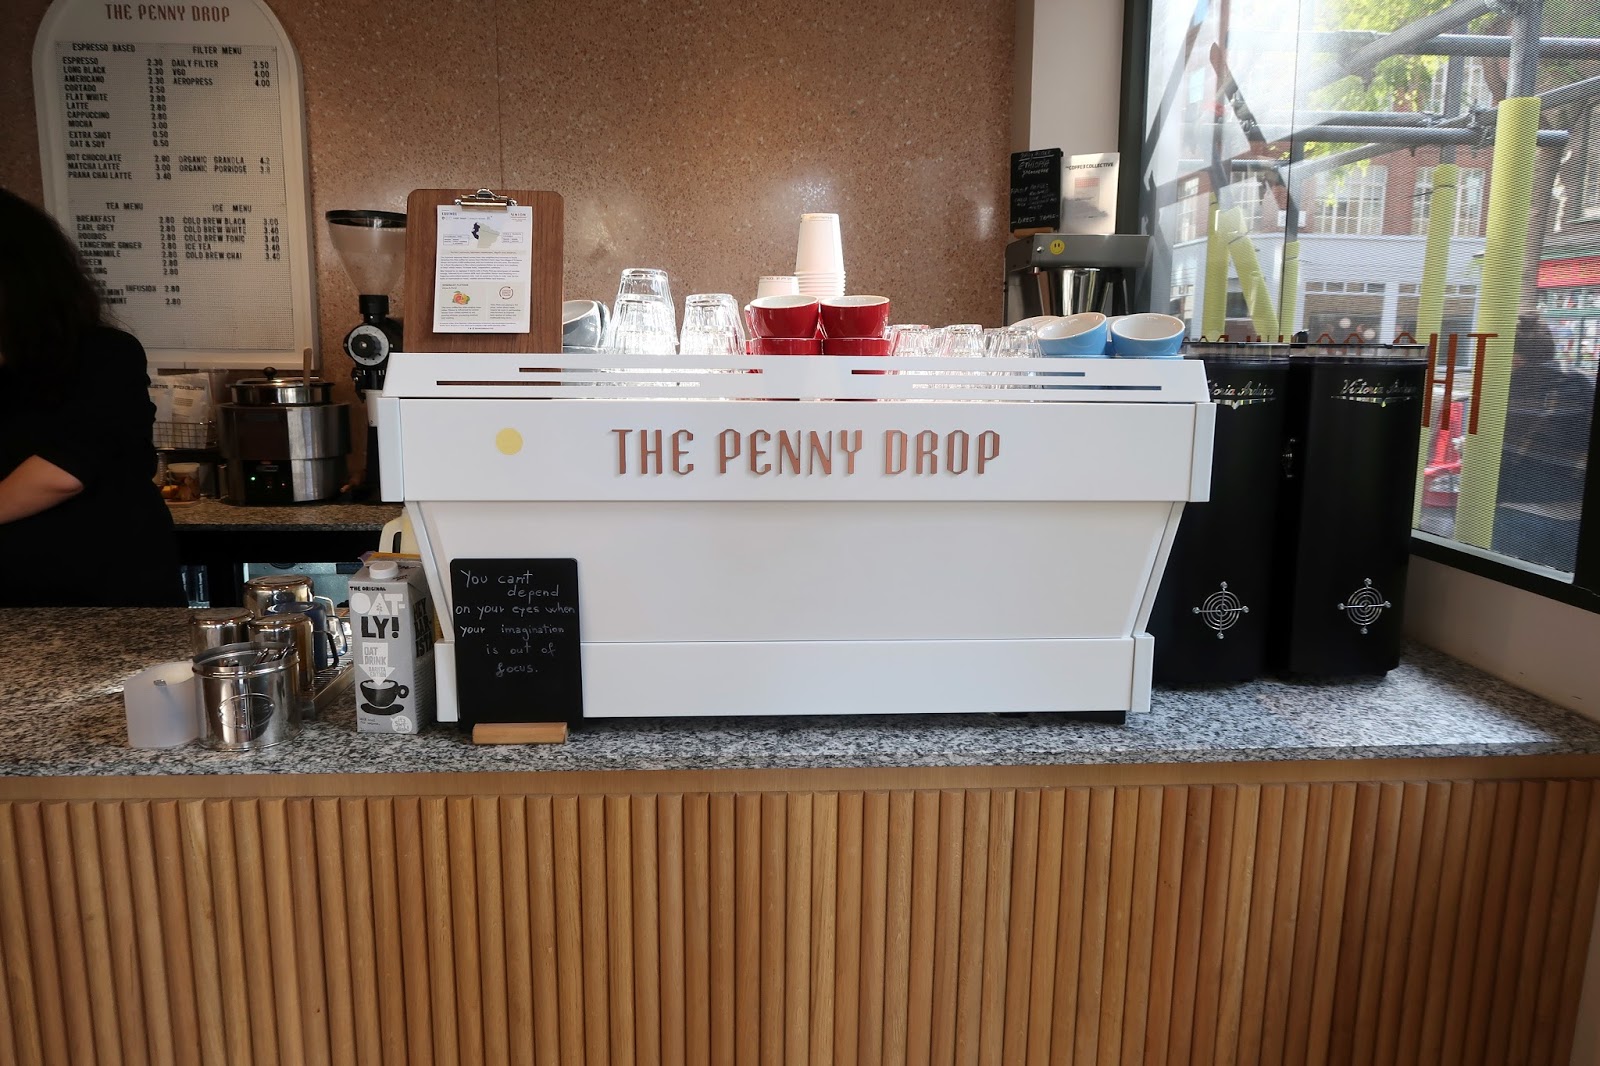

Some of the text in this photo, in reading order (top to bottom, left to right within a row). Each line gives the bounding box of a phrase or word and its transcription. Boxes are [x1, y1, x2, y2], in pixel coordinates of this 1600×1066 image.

[105, 4, 230, 22] THE PENNY DROP
[72, 43, 136, 52] ESPRESSO BASED
[193, 46, 242, 55] FILTER MENU
[62, 56, 98, 65] ESPRESSO
[146, 58, 163, 67] 2.30
[171, 59, 218, 68] DAILY FILTER
[63, 66, 106, 74] LONG BLACK
[148, 67, 164, 75] 2.30
[64, 75, 104, 83] AMERICANO
[173, 77, 213, 85] AEROPRESS
[64, 84, 97, 92] CORTADO
[66, 93, 108, 101] FLAT WHITE
[66, 102, 89, 110] LATTE
[67, 111, 110, 119] CAPPUCCINO
[151, 112, 167, 120] 2.80
[68, 120, 93, 128] MOCHA
[69, 131, 91, 139] EXTRA
[92, 140, 105, 148] SOY
[82, 154, 122, 162] CHOCOLATE
[214, 156, 244, 164] GRANOLA
[180, 164, 247, 173] ORGANIC PORRIDGE
[156, 172, 172, 180] 3.40
[106, 202, 119, 210] TEA
[212, 204, 252, 213] ICE MENU
[158, 216, 175, 224] 2.80
[225, 226, 246, 234] WHITE
[161, 242, 177, 250] 2.80
[164, 285, 180, 293] 2.80
[1340, 378, 1384, 395] Victoria
[611, 428, 1000, 475] THE PENNY DROP
[460, 570, 488, 588] You
[507, 584, 559, 604] depend
[351, 593, 406, 616] OAT-
[455, 602, 575, 620] on your eyes when
[361, 616, 400, 639] LY!
[460, 624, 565, 642] your imagination
[364, 647, 378, 655] OAT
[486, 642, 556, 657] is out of
[364, 656, 386, 665] DRINK
[496, 662, 538, 678] focus.
